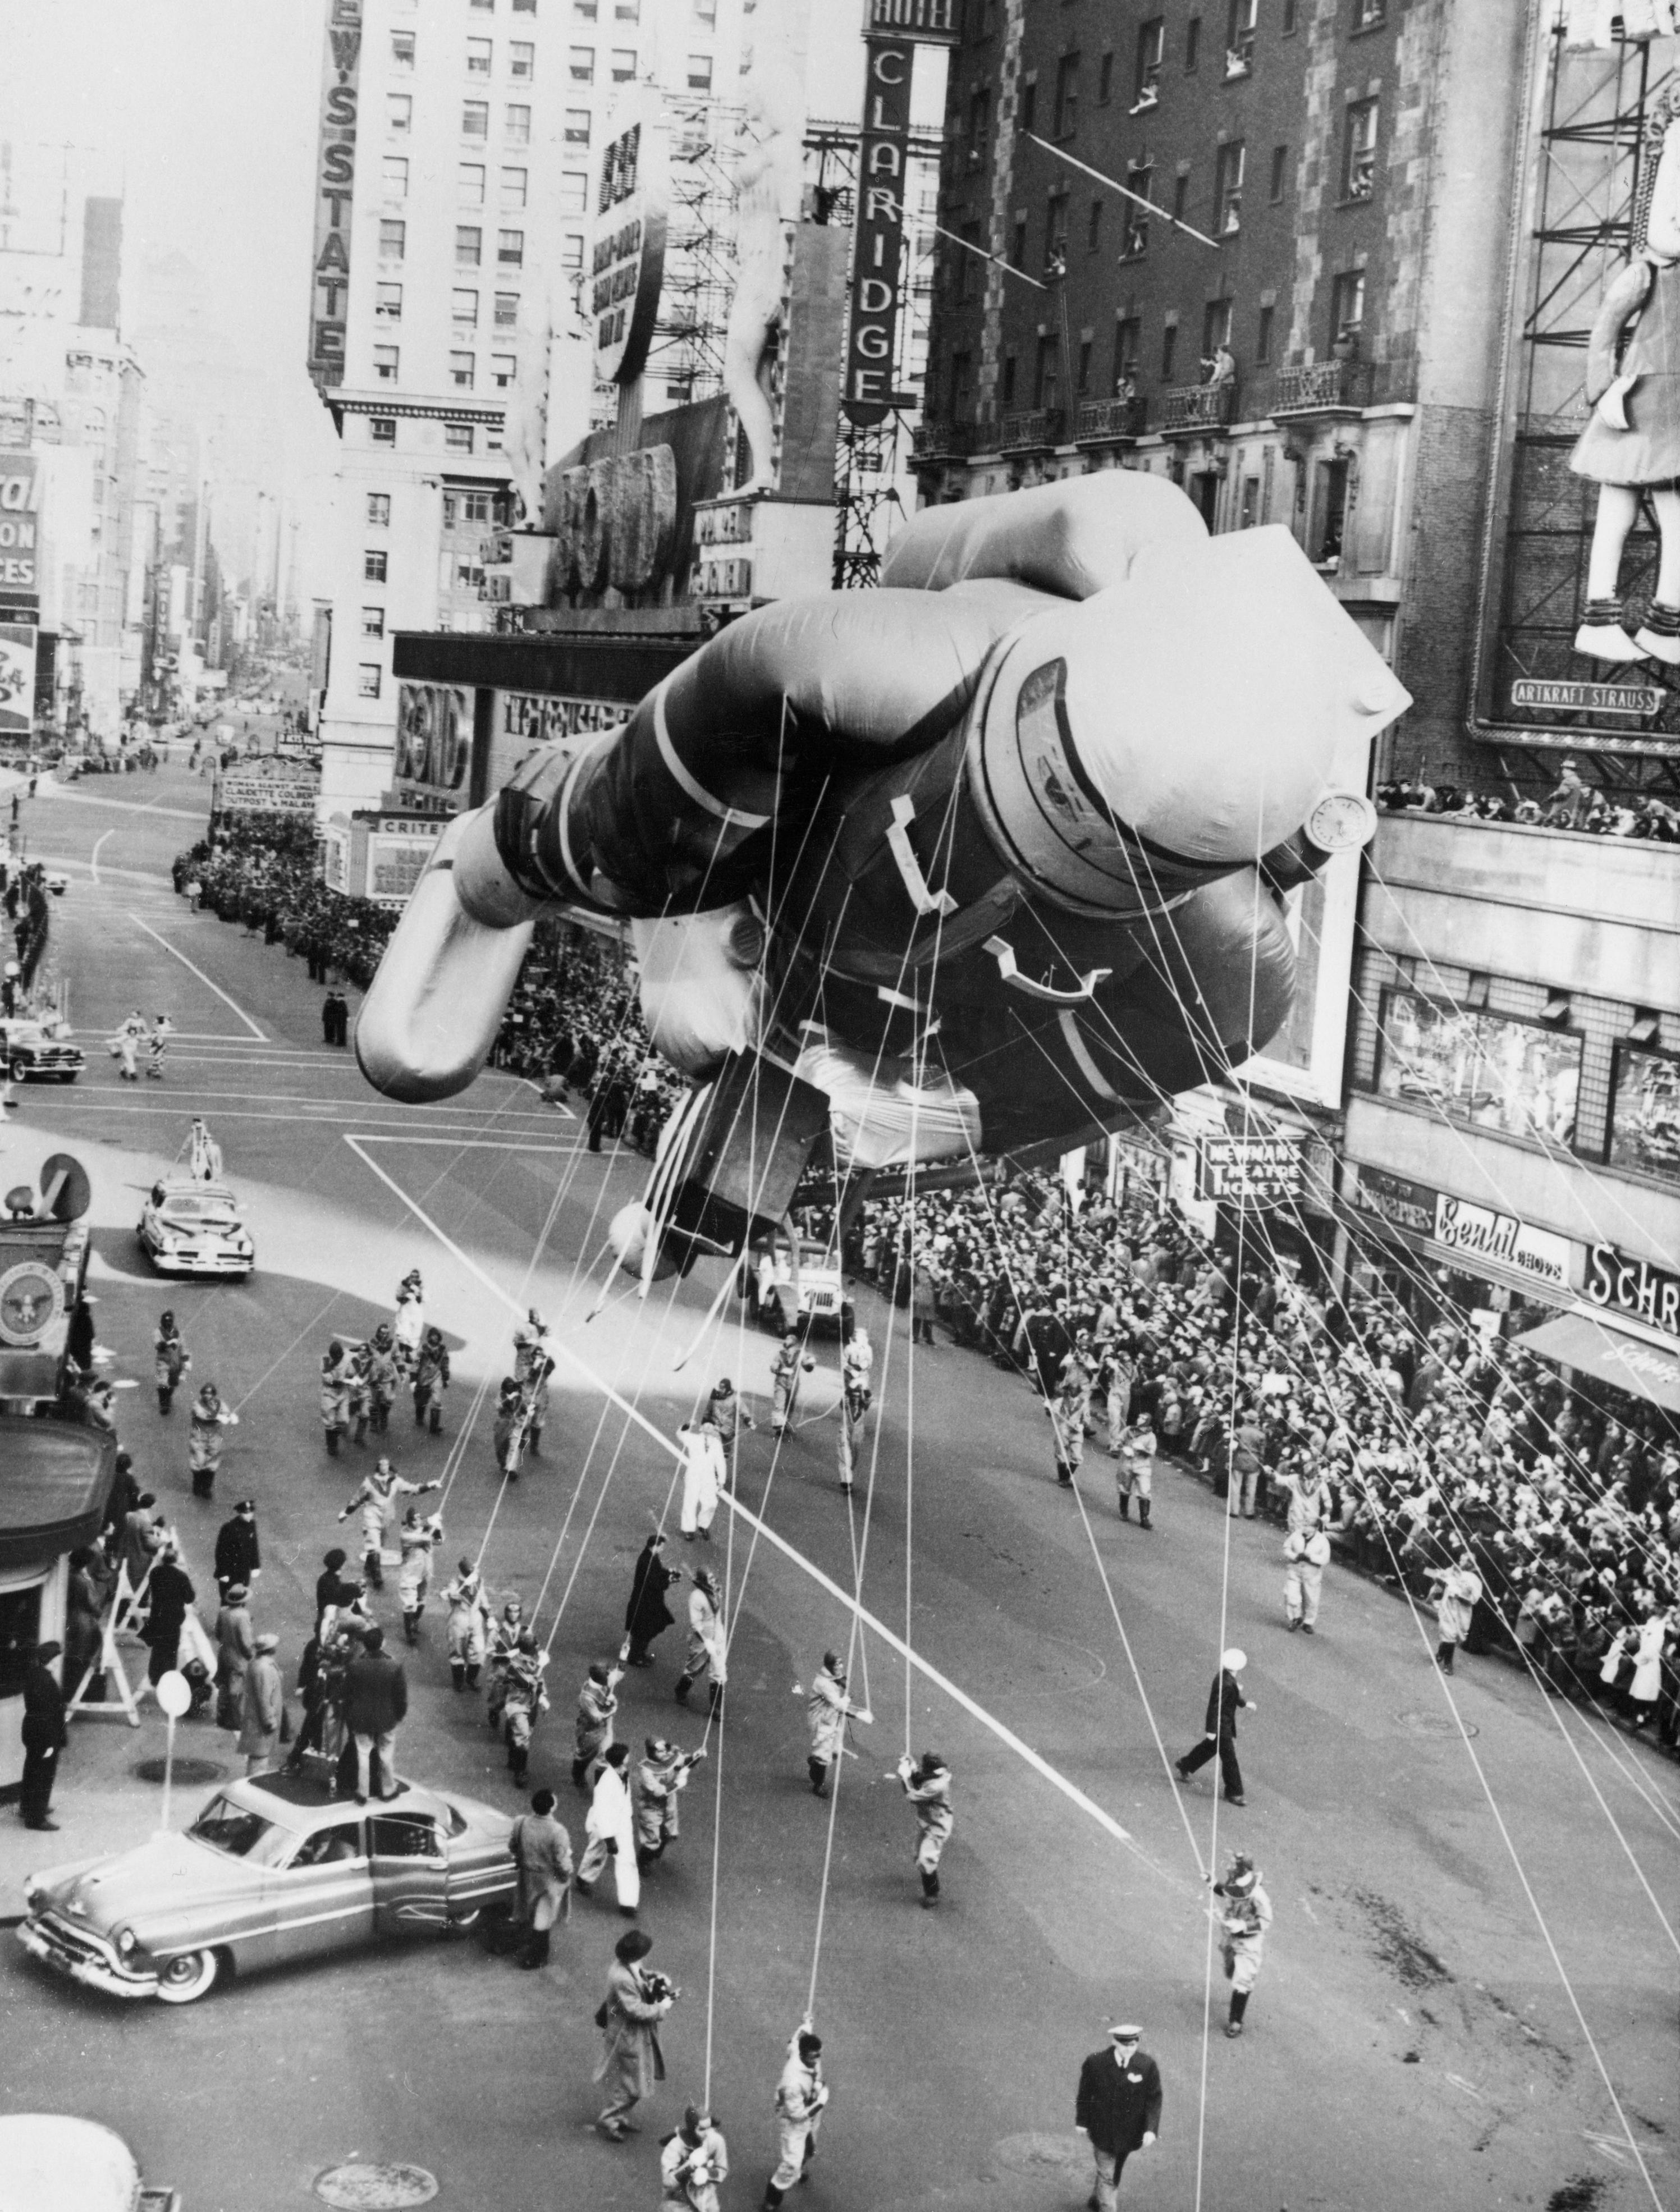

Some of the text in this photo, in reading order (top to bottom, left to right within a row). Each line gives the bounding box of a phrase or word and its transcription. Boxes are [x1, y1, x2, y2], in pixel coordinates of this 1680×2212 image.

[855, 49, 904, 401] CLARIDGE
[314, 144, 354, 361] STATE
[1517, 684, 1654, 709] ARTKRAFT STRAUSS
[225, 797, 267, 805] OUTPOST
[226, 788, 317, 800] CLAUDETTE COLBER
[385, 821, 447, 835] CRITE
[1517, 1249, 1562, 1280] SHOPS
